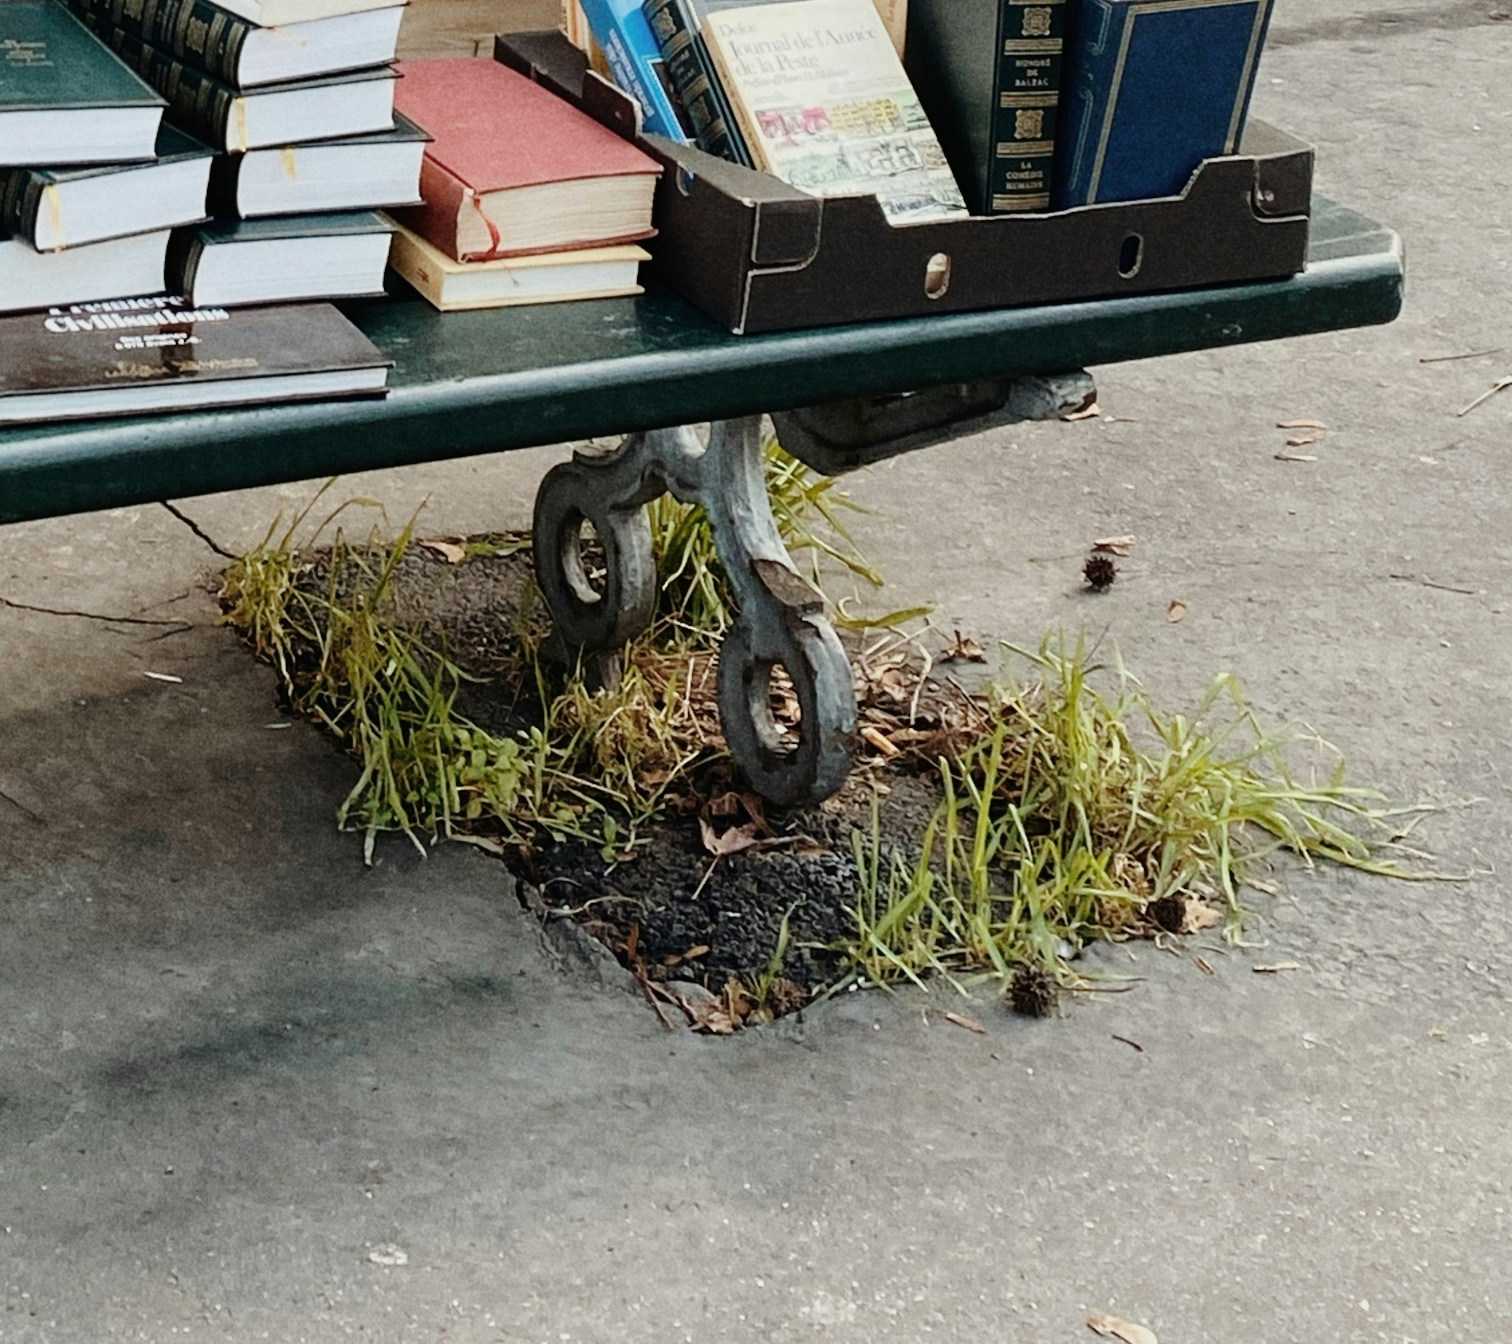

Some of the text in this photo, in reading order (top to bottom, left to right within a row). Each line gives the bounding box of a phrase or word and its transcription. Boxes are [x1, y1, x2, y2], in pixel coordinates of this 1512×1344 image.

[728, 32, 794, 63] Journal
[794, 31, 814, 50] de
[734, 53, 821, 76] de la Peste
[1014, 78, 1049, 87] BALZAC
[1020, 161, 1032, 170] LA
[43, 307, 230, 333] Civilisations
